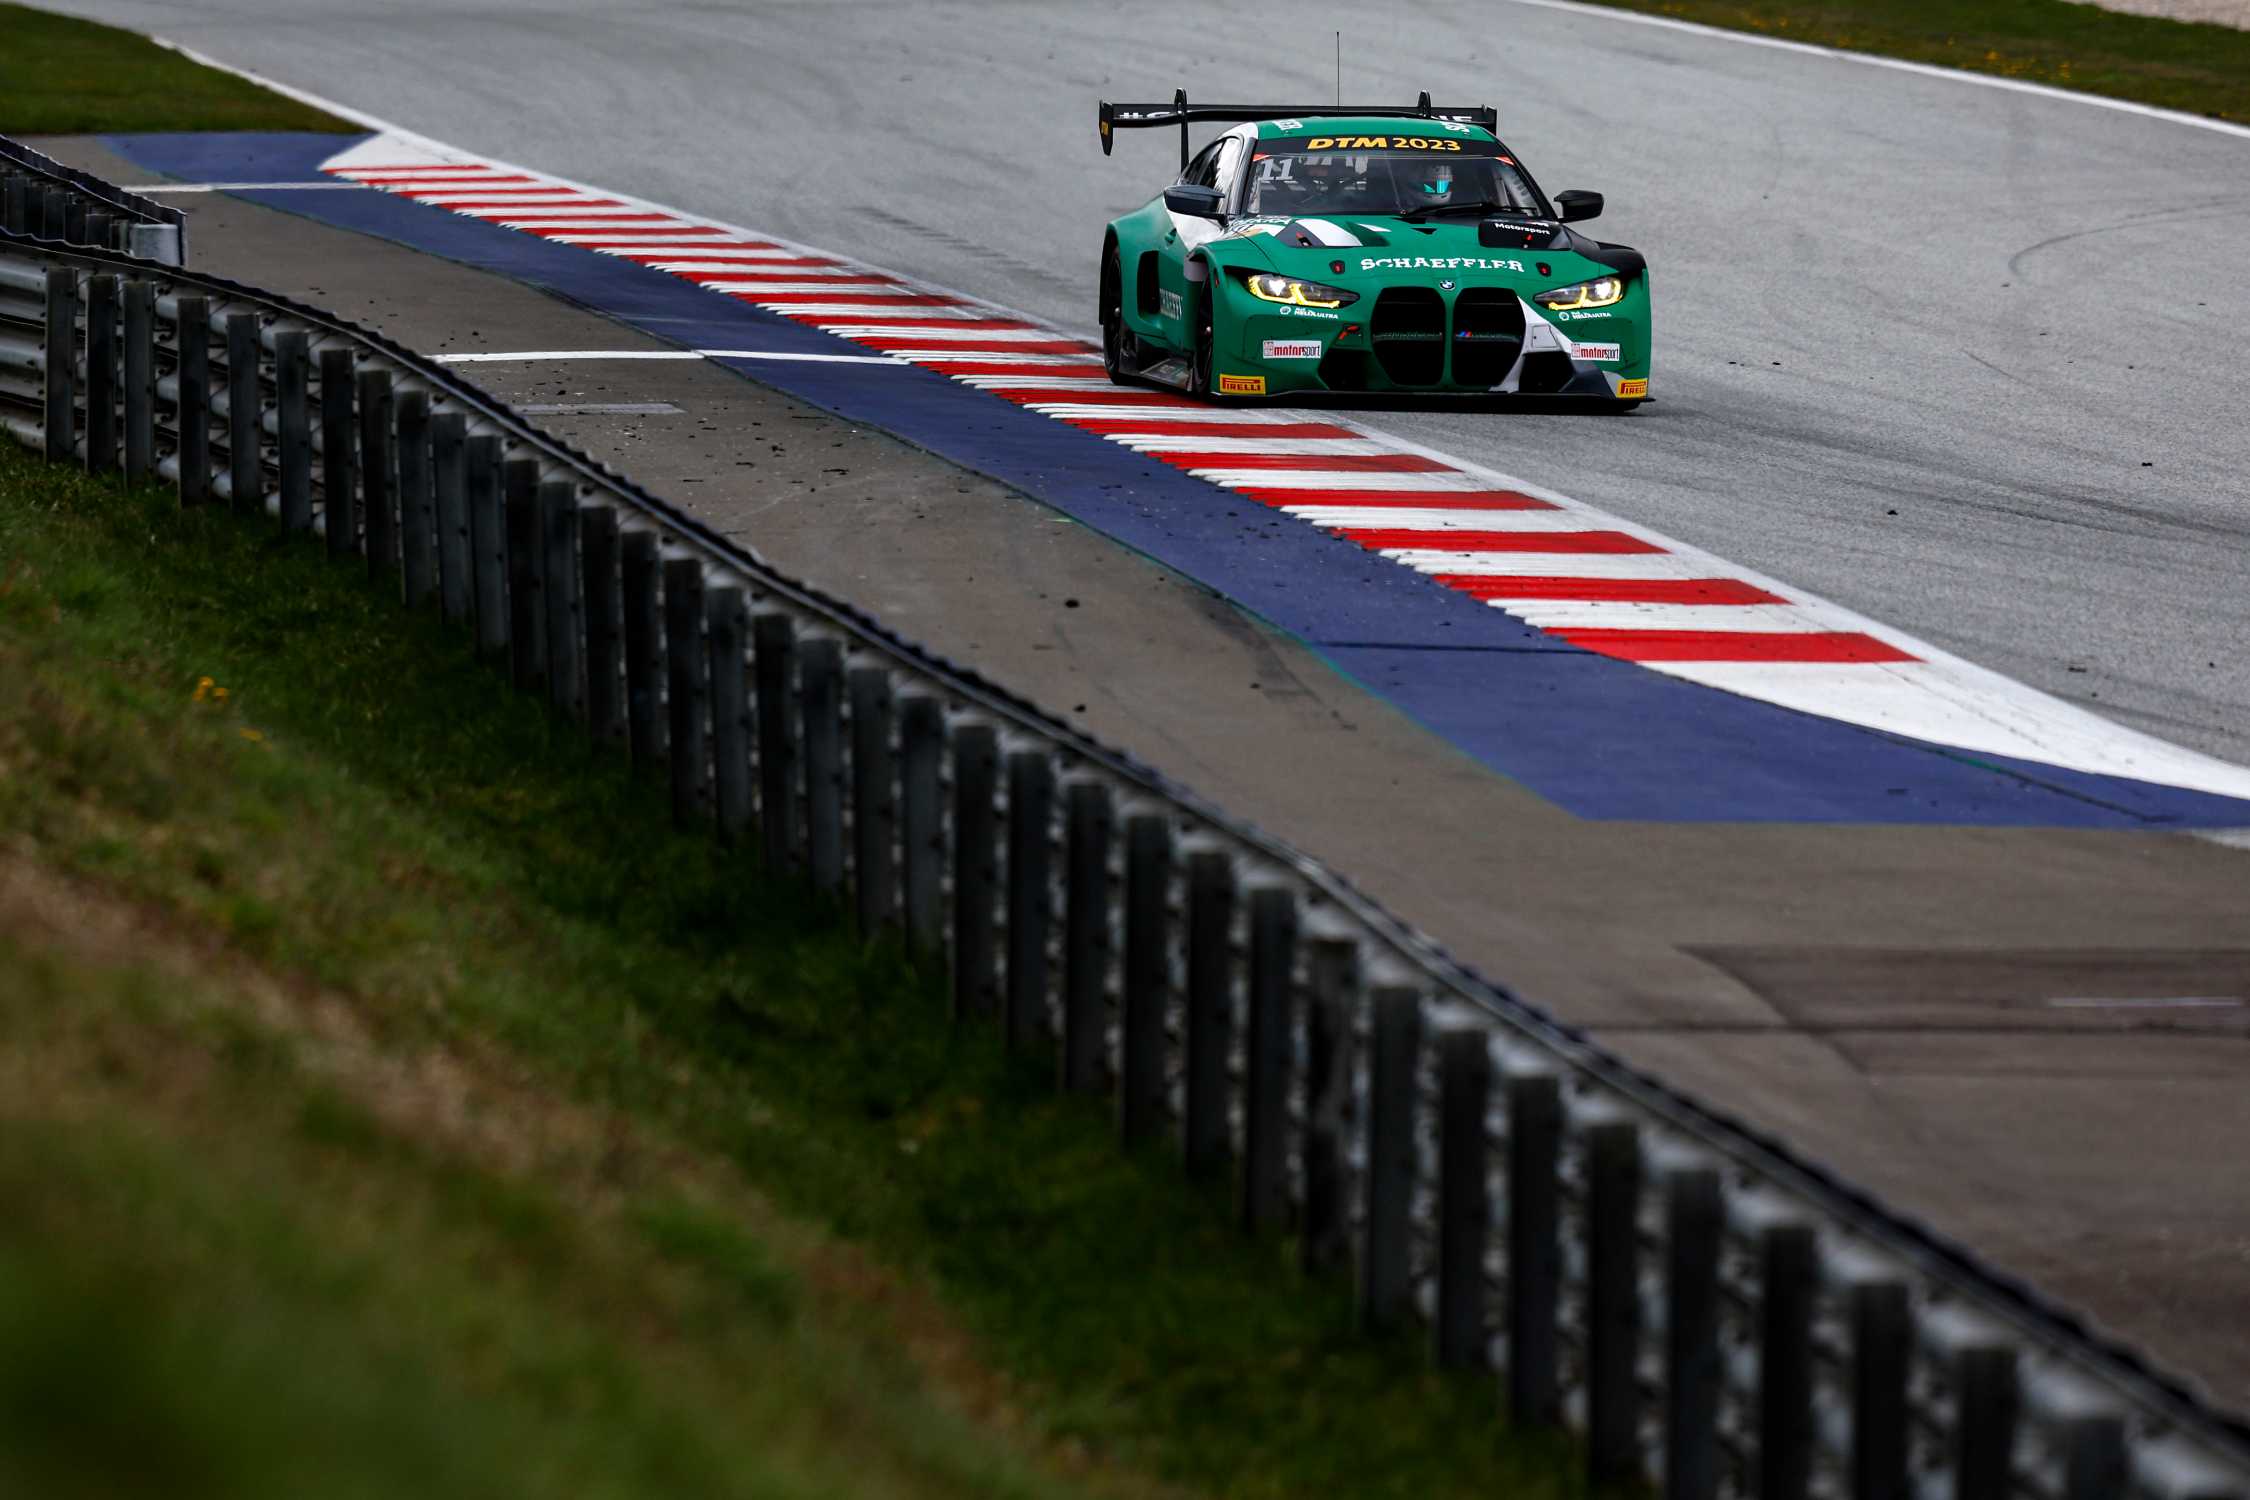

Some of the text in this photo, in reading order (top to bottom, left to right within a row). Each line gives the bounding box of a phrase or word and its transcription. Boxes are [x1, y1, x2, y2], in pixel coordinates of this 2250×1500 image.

[1307, 137, 1461, 151] DTM 2023
[1258, 158, 1294, 181] 11
[1494, 222, 1550, 235] Motorsport
[1360, 257, 1525, 273] SCHAEFFLER
[1274, 344, 1320, 357] motorsport
[1580, 346, 1619, 360] motorsport
[1222, 377, 1262, 391] PIRELLI
